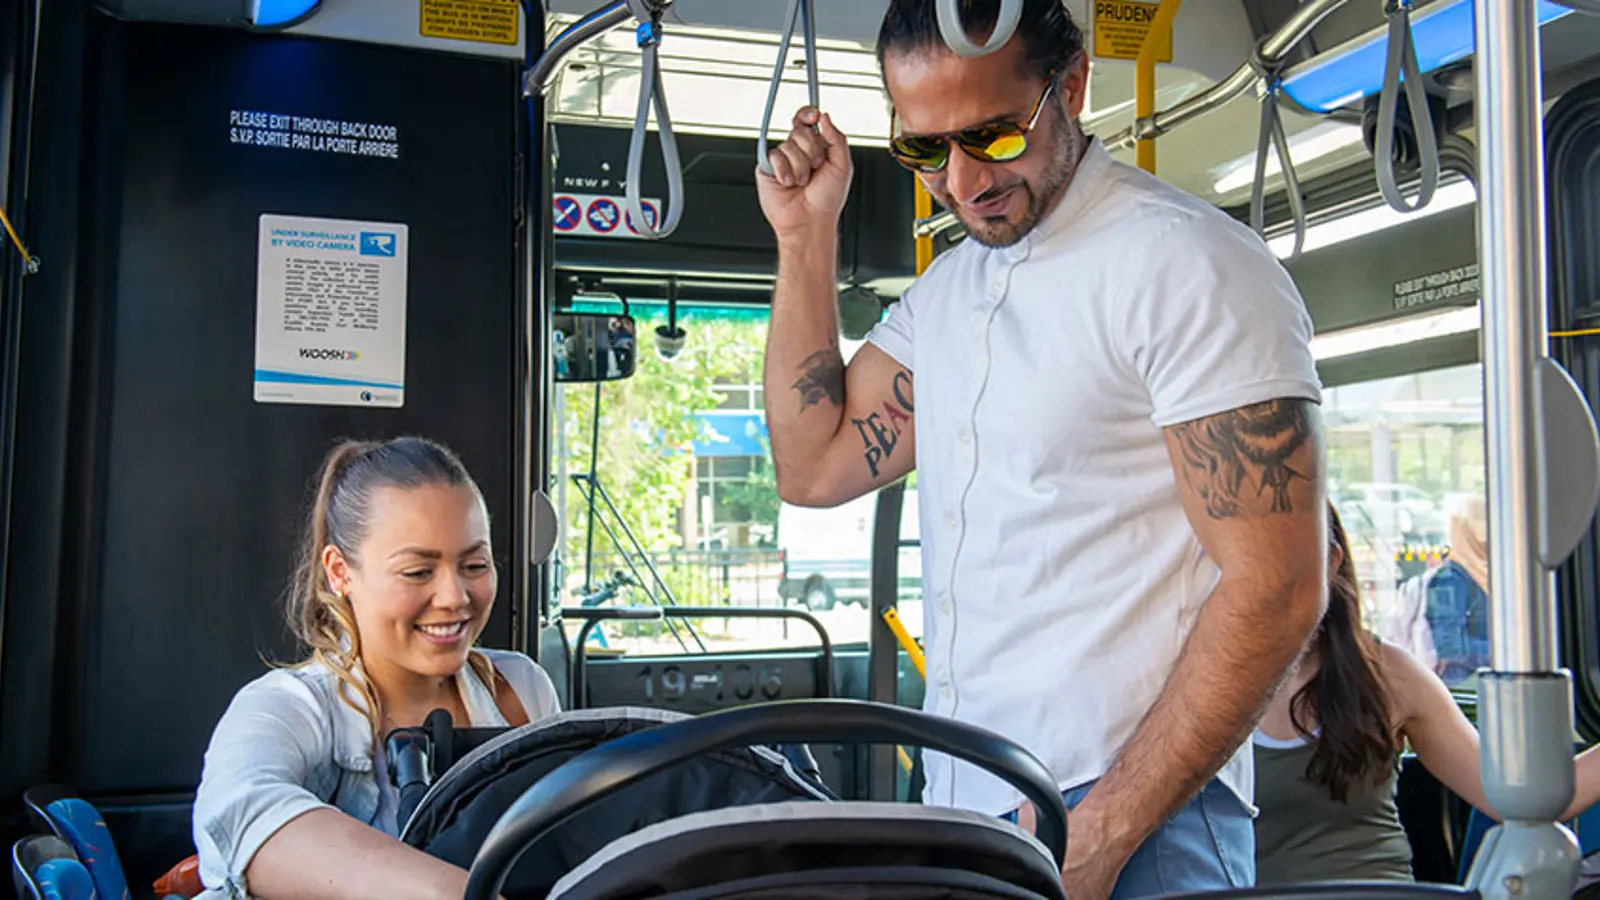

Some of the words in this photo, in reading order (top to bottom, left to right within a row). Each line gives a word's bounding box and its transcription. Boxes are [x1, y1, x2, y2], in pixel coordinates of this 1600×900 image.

[230, 110, 268, 129] PLEASE
[269, 114, 291, 131] EXIT
[292, 116, 339, 135] THROUGH
[341, 121, 368, 138] BACK
[368, 124, 397, 141] DOOR
[230, 128, 254, 145] S.V.P.
[255, 130, 291, 149] SORTIE
[292, 134, 311, 150] PAR
[312, 136, 325, 151] LA
[326, 137, 358, 154] PORTE
[563, 177, 598, 188] NEW
[271, 229, 299, 237] UNDER
[300, 230, 356, 241] SURVEILLANCE
[271, 238, 283, 247] BY
[285, 239, 315, 249] VIDEO
[316, 241, 357, 252] CAMERA
